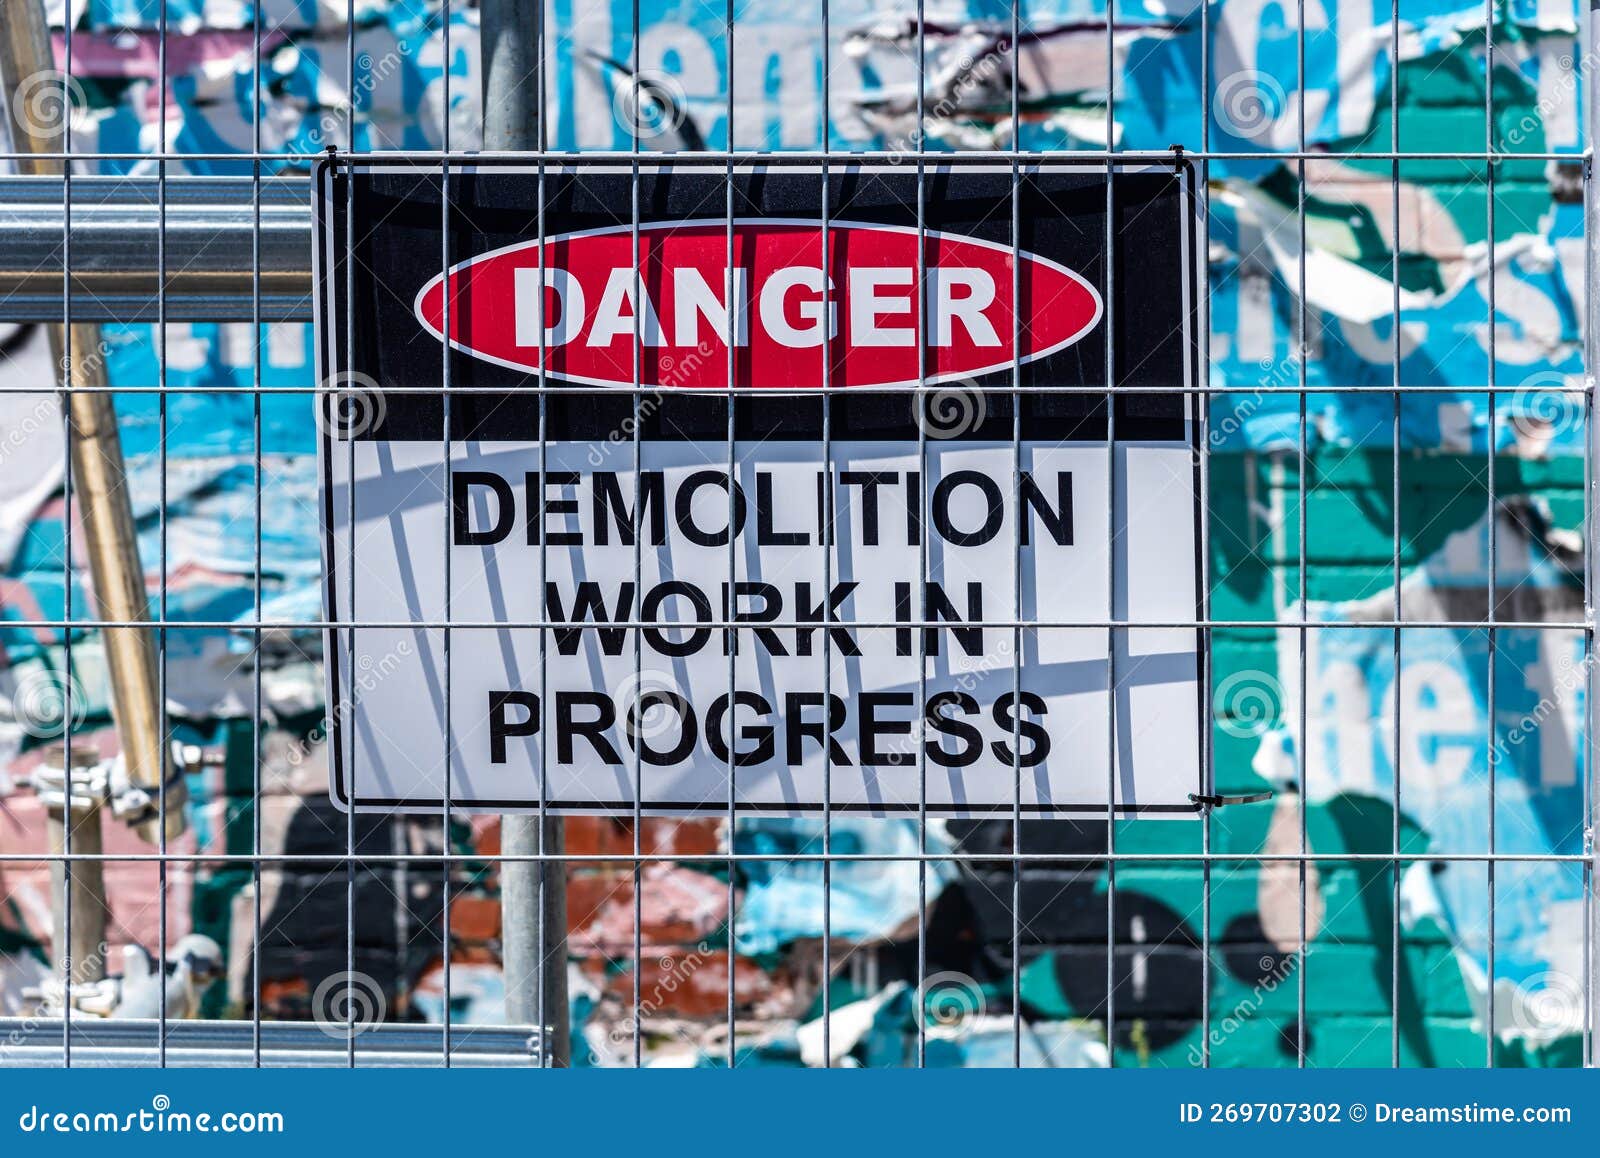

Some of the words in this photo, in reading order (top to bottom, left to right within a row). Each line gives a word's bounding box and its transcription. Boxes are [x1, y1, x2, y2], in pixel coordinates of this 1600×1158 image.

[514, 266, 1003, 349] DANGER
[452, 470, 1075, 547] DEMOLITION
[545, 580, 863, 657] WORK
[896, 582, 984, 657] IN
[488, 690, 1052, 768] PROGRESS
